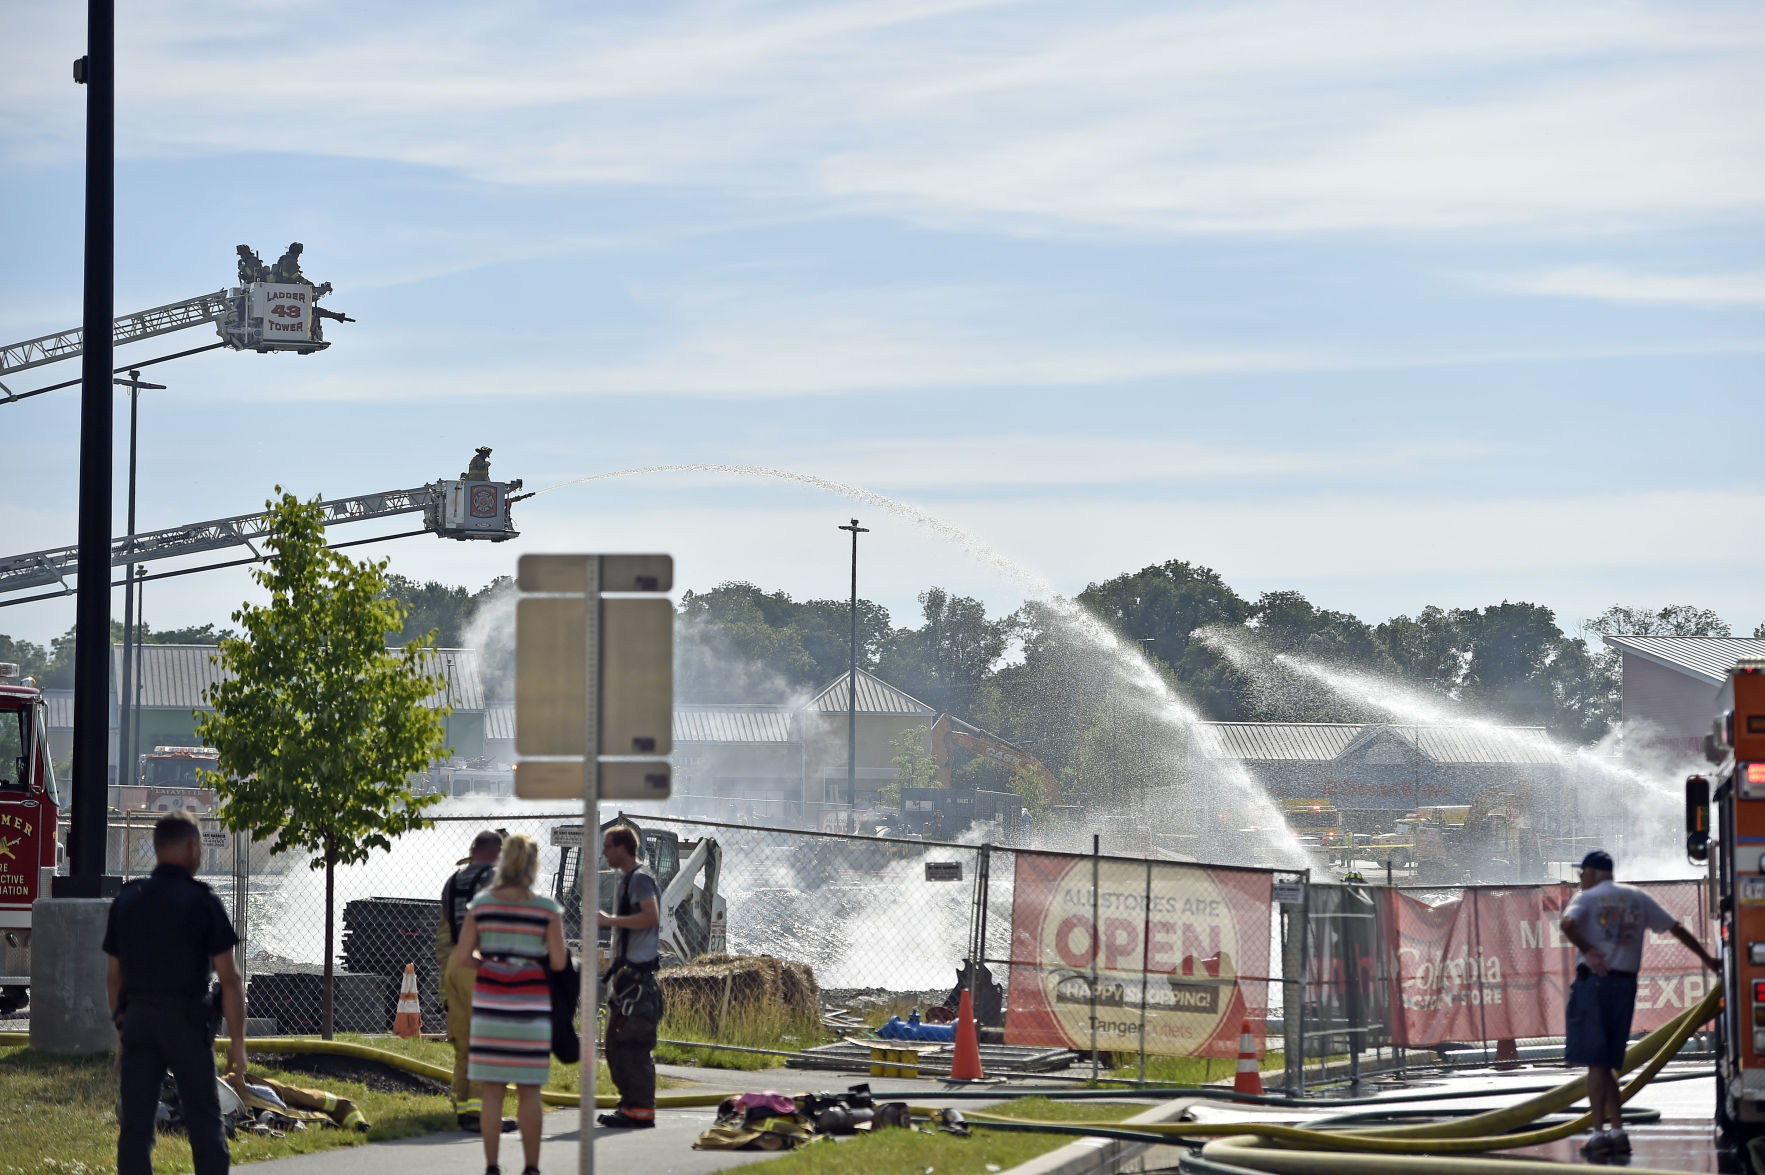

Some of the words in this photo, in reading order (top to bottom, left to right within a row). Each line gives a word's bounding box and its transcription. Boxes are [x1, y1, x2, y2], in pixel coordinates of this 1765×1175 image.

[267, 291, 305, 303] LADDER
[271, 304, 300, 318] 43
[268, 319, 303, 332] TOWER
[1064, 888, 1096, 908] ALL
[1181, 897, 1220, 917] ARE
[1055, 913, 1221, 977] OPEN
[1066, 983, 1123, 1001] HAPPY
